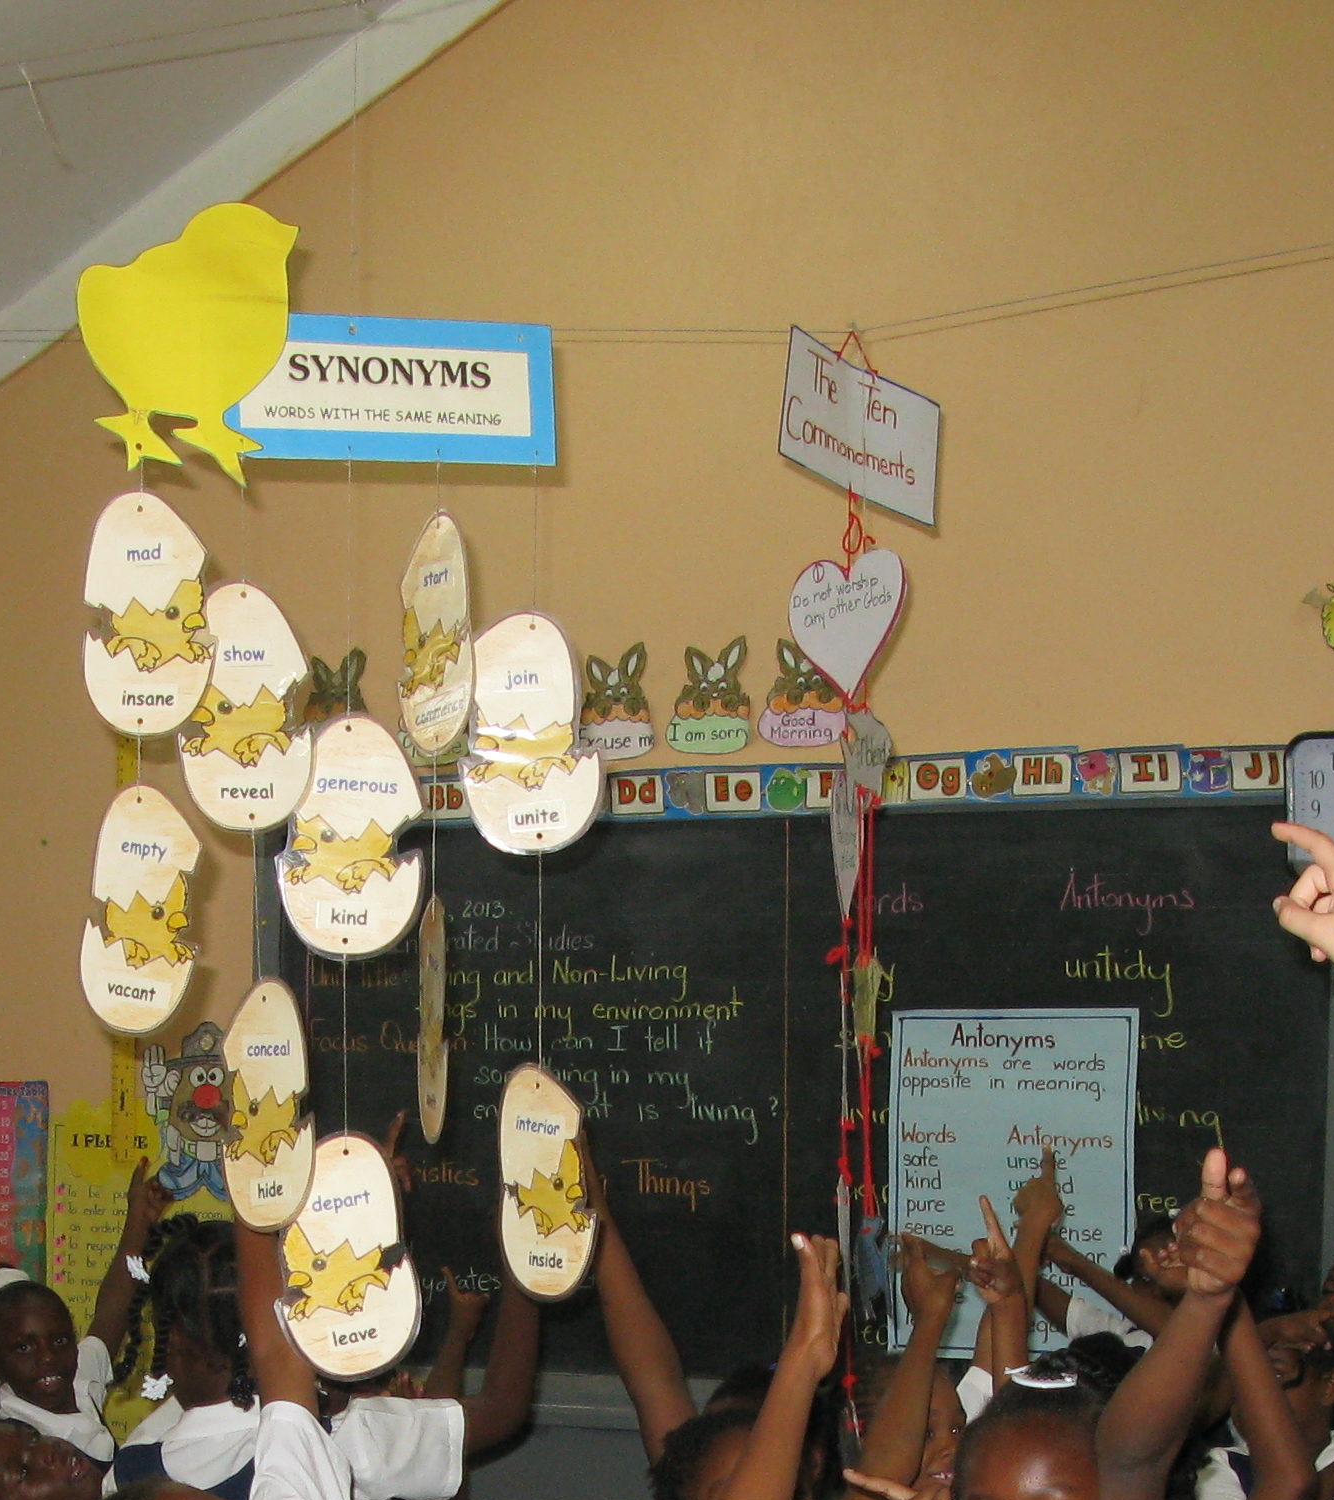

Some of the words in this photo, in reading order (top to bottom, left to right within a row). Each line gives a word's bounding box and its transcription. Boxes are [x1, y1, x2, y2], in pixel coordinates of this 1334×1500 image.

[288, 353, 492, 389] SYNONYMS
[807, 349, 838, 404] The
[858, 381, 897, 429] Ten
[264, 405, 315, 419] WORDS
[319, 407, 360, 421] WITH
[364, 408, 390, 422] THE
[395, 410, 432, 424] SAME
[437, 411, 502, 426] MEANING
[785, 395, 915, 486] Commandments
[126, 543, 161, 563] mad
[423, 567, 449, 588] start
[793, 595, 809, 608] Do
[813, 582, 832, 602] not
[836, 573, 878, 600] worship
[804, 611, 826, 629] any
[828, 597, 860, 620] other
[863, 585, 892, 609] Gods
[223, 645, 265, 662] show
[504, 669, 539, 691] join
[121, 689, 174, 707] insane
[781, 712, 815, 727] Good
[770, 725, 833, 742] Morning
[916, 764, 961, 795] Gg
[1022, 757, 1063, 786] Hh
[1309, 770, 1325, 790] 10
[220, 782, 274, 799] reveal
[317, 775, 398, 795] generous
[514, 808, 560, 827] unite
[1311, 800, 1321, 819] 9
[121, 840, 167, 862] empty
[1061, 870, 1194, 936] Antonyms
[330, 908, 368, 926] kind
[494, 961, 533, 985] and
[552, 955, 688, 1002] Non-Living
[1065, 946, 1174, 1017] untidy
[108, 981, 156, 1002] vacant
[498, 1000, 517, 1019] in
[535, 1005, 571, 1038] my
[593, 986, 743, 1020] environment
[485, 1023, 532, 1051] How
[551, 1035, 592, 1050] can
[607, 1025, 629, 1051] I
[645, 1024, 677, 1051] tell
[697, 1020, 715, 1055] if
[951, 1022, 1056, 1056] Antonyms
[247, 1040, 290, 1057] conceal
[903, 1047, 988, 1074] Antonyms
[1003, 1059, 1032, 1071] are
[1053, 1053, 1106, 1072] words
[902, 1071, 971, 1097] opposite
[989, 1076, 1005, 1089] in
[1017, 1078, 1106, 1101] meaning.
[516, 1116, 560, 1136] interior
[639, 1104, 659, 1122] is
[691, 1094, 758, 1145] living
[769, 1096, 778, 1117] ?
[901, 1121, 956, 1144] Words
[1007, 1124, 1113, 1157] Antonyms
[903, 1147, 938, 1167] safe
[621, 1158, 711, 1212] Things
[905, 1169, 941, 1190] kind
[257, 1182, 284, 1200] hide
[312, 1190, 371, 1214] depart
[906, 1198, 945, 1223] pure
[905, 1221, 954, 1237] sense
[528, 1252, 563, 1269] inside
[332, 1327, 378, 1347] leave
